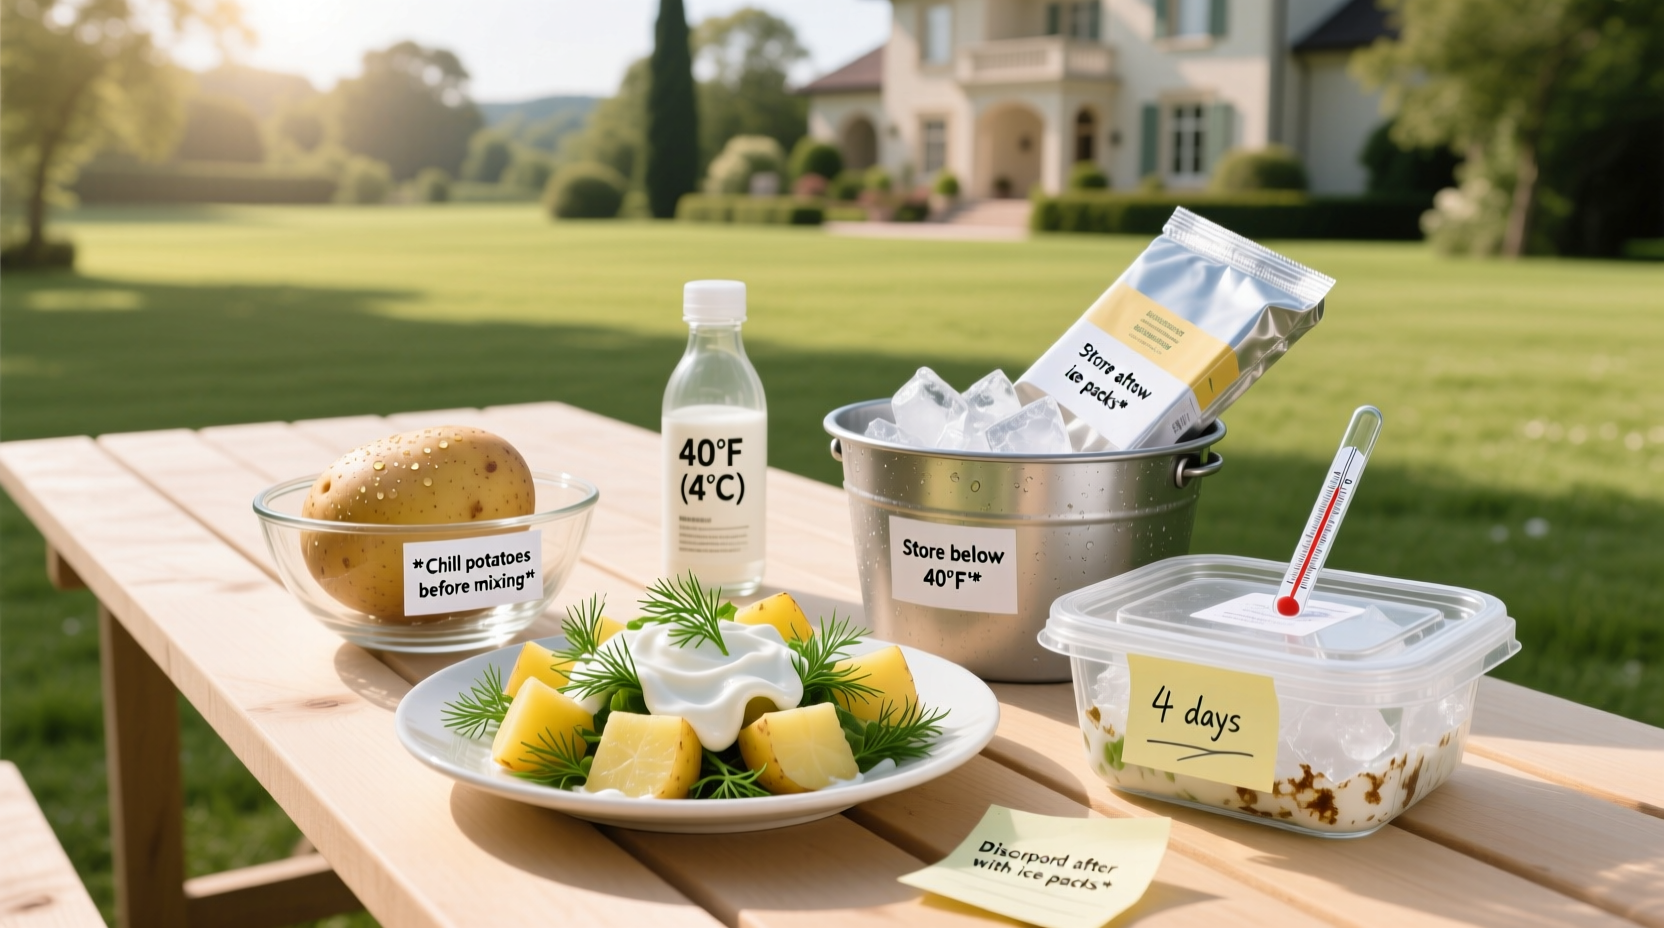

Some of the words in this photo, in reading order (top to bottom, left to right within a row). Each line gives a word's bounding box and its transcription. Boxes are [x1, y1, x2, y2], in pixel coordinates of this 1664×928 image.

[679, 437, 743, 467] 40°F
[681, 472, 745, 505] (4°C)
[466, 550, 531, 574] potatoes
[902, 538, 945, 560] Store
[950, 543, 1005, 565] below
[419, 580, 470, 598] before
[1151, 685, 1174, 723] 4
[1184, 694, 1241, 742] days
[973, 858, 1012, 874] with
[1017, 866, 1044, 880] ice
[1073, 858, 1119, 875] after
